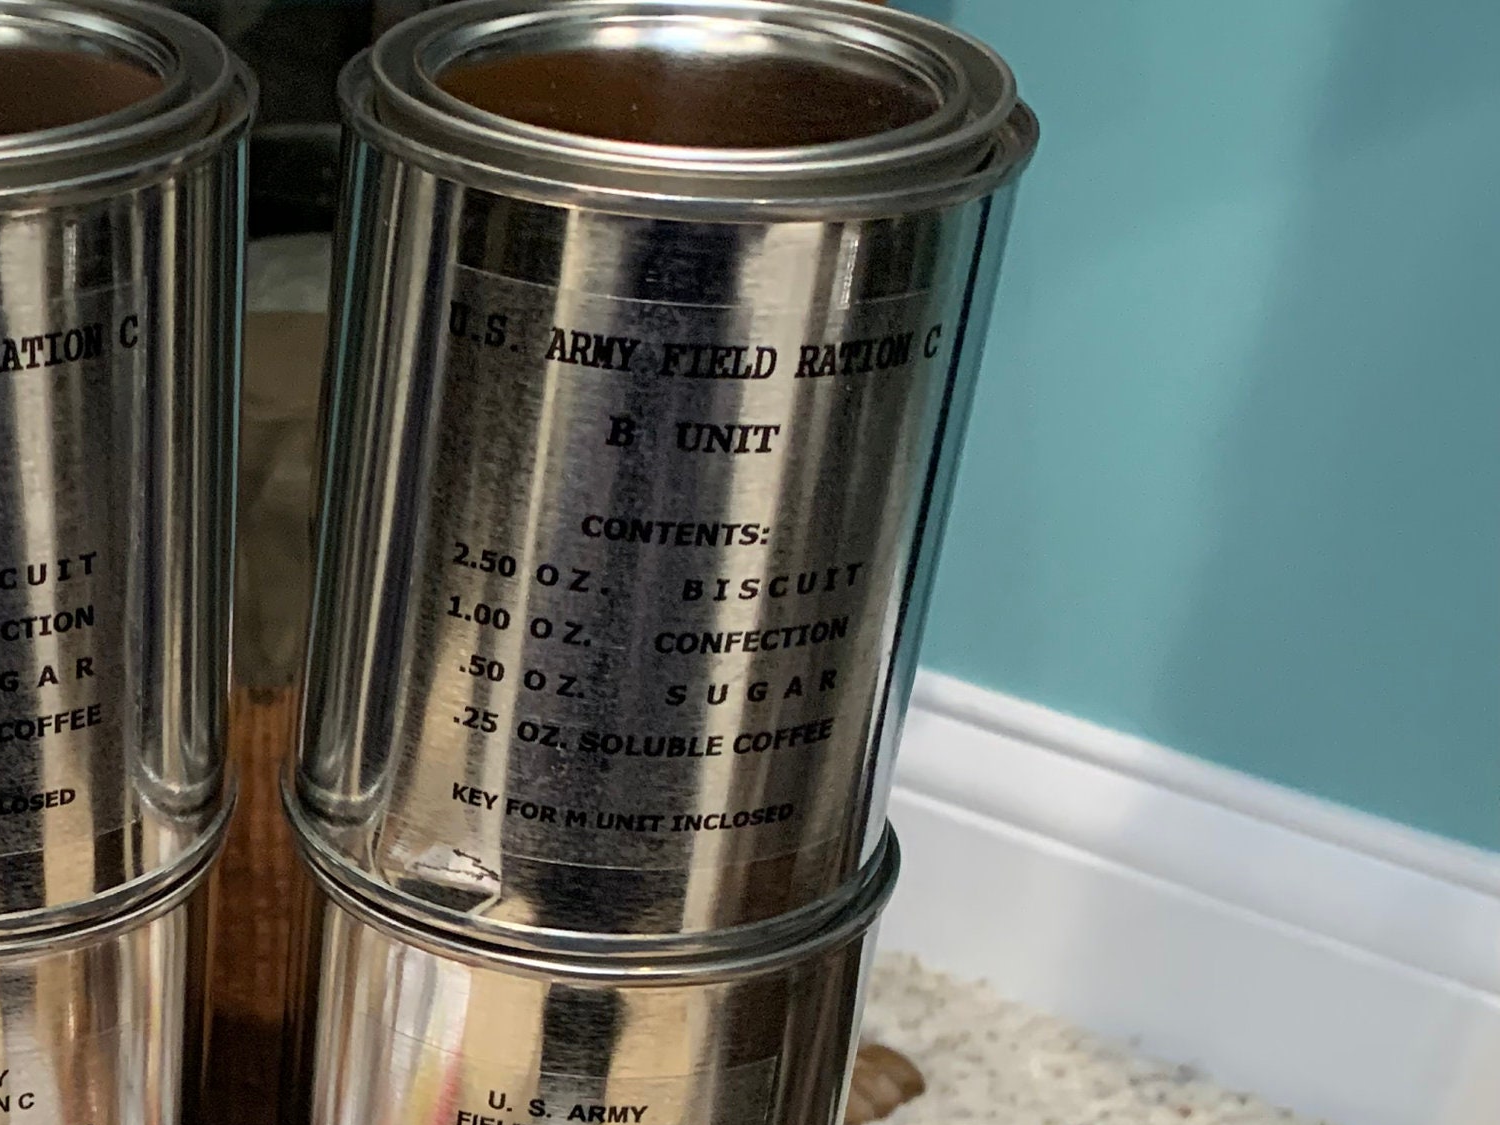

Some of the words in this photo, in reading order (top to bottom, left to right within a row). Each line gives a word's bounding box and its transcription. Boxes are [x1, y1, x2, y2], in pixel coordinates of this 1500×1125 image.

[119, 316, 138, 348] C
[545, 327, 640, 372] ARMY
[661, 343, 777, 379] FIELD
[795, 332, 912, 378] RATION
[924, 325, 942, 358] C
[606, 416, 636, 448] B
[677, 423, 779, 454] UNIT
[581, 515, 770, 546] CONTENTS:
[453, 543, 516, 578] 2.50
[536, 565, 609, 595] OZ.
[682, 562, 863, 601] BISCUIT
[448, 597, 510, 630] 1.00
[530, 618, 592, 647] OZ.
[654, 616, 849, 655] CONFECTION
[459, 656, 505, 682] .50
[524, 670, 584, 699] OZ.
[665, 669, 837, 705] SUGAR
[453, 708, 498, 733] .25
[517, 721, 567, 748] OZ.
[579, 731, 723, 757] SOLUBLE
[732, 718, 832, 755] COFFEE
[452, 783, 498, 809] KEY
[505, 799, 556, 823] FOR
[566, 809, 588, 827] M
[596, 813, 665, 832] UNIT
[672, 803, 793, 832] INCLOSED
[18, 1092, 35, 1110] C
[488, 1091, 512, 1112] U.
[528, 1099, 552, 1117] S.
[568, 1104, 648, 1124] ARMY
